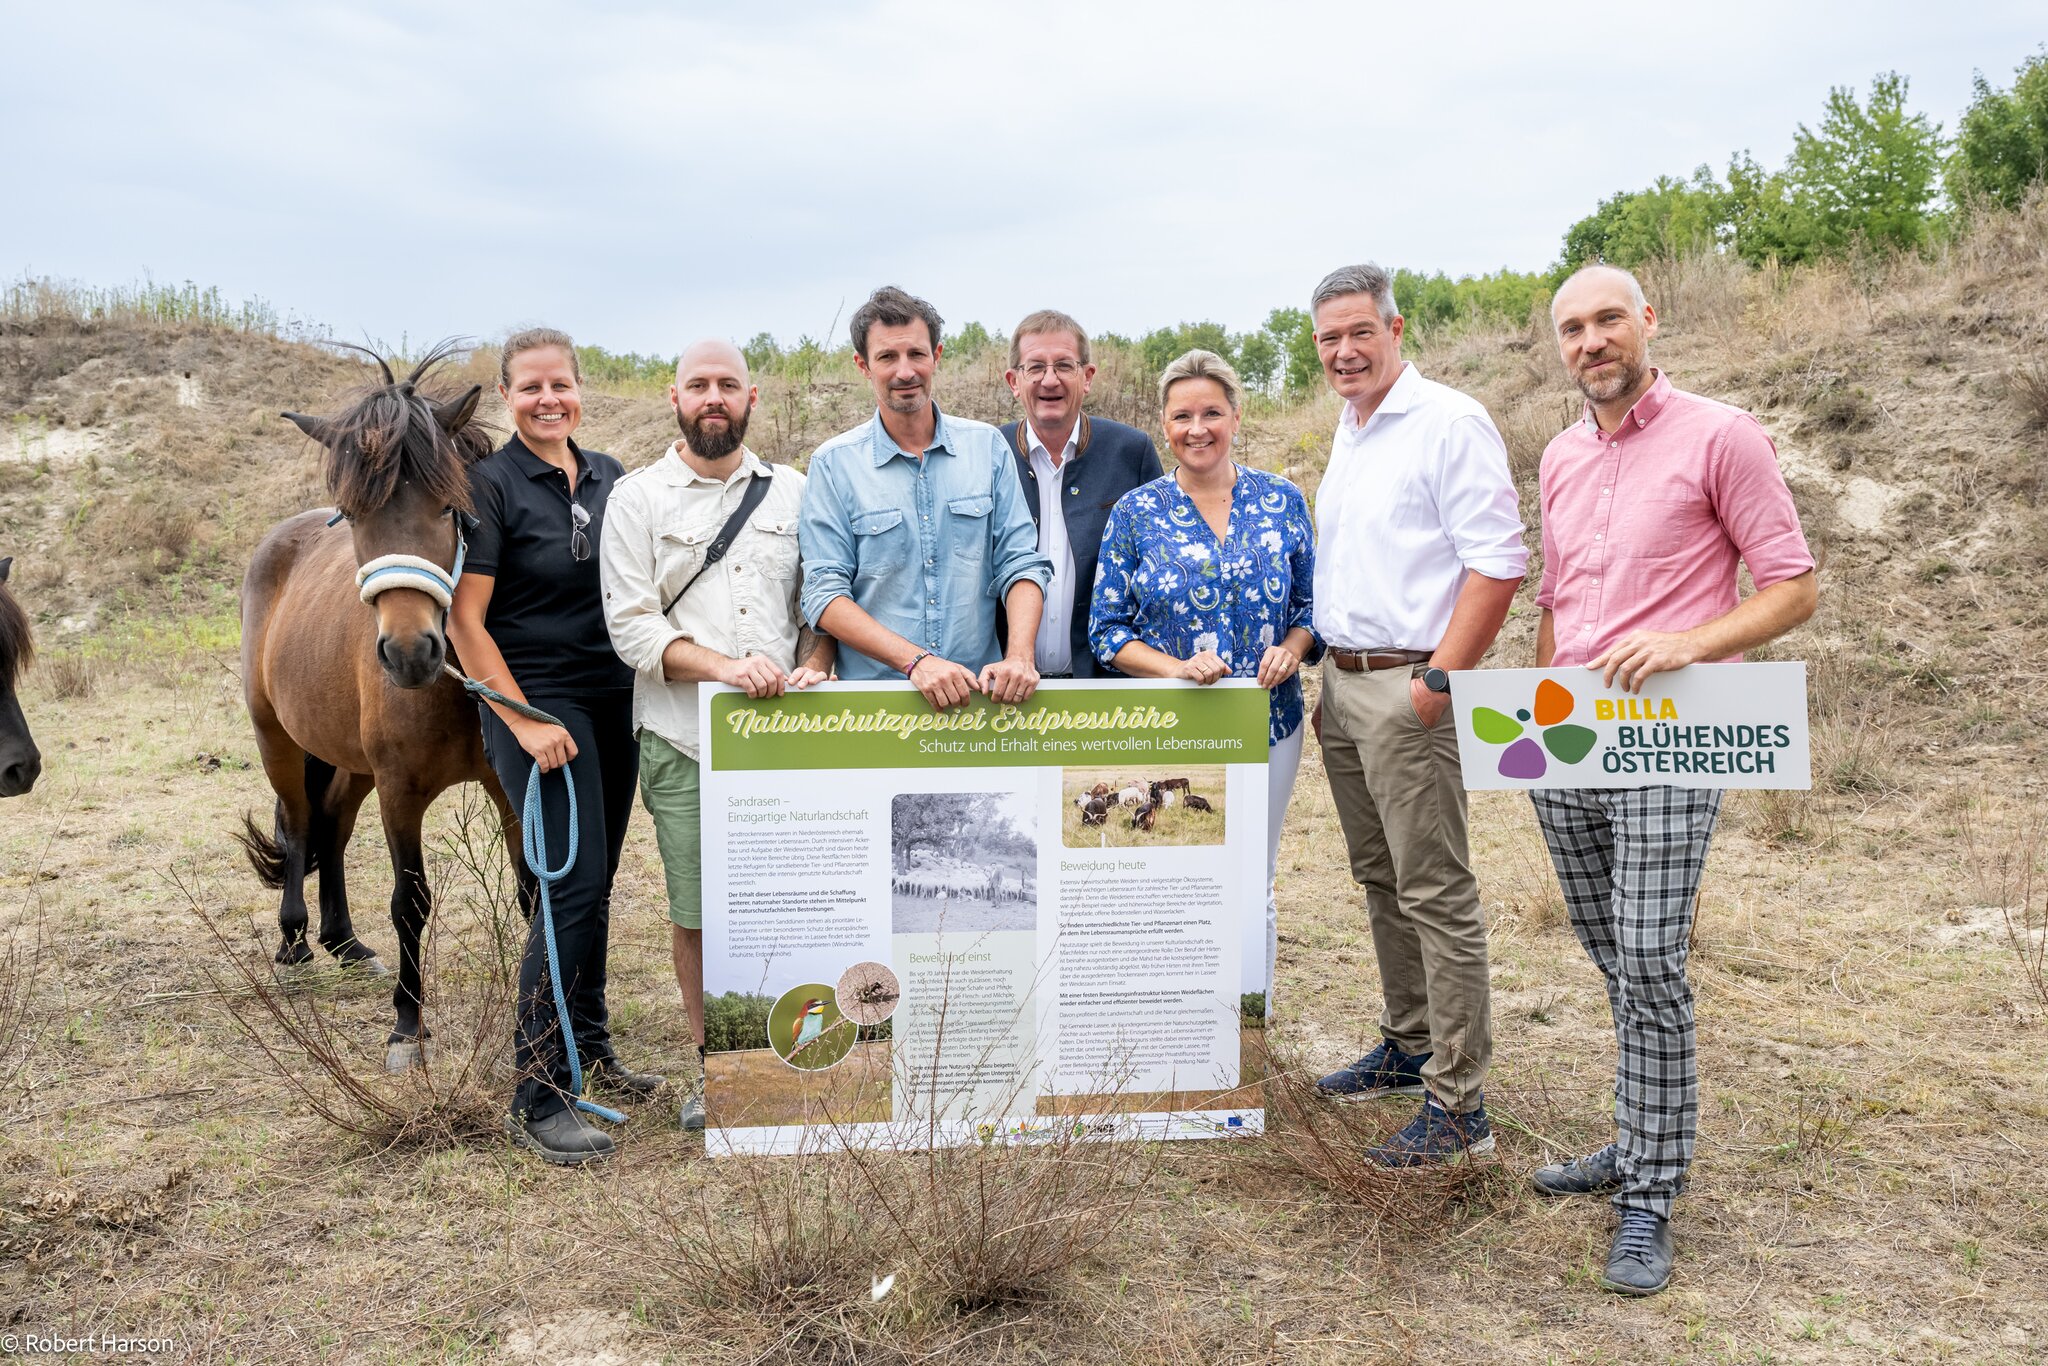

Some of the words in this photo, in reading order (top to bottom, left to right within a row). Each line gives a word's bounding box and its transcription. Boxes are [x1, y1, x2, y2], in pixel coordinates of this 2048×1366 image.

[1595, 698, 1678, 720] BILLA
[726, 708, 987, 739] Naturschutzgebiet
[991, 704, 1179, 735] Erdpresshöhe
[1618, 723, 1790, 748] BLÜHENDES
[919, 739, 965, 752] Schutz
[970, 739, 995, 752] und
[1002, 738, 1038, 751] Erhalt
[1043, 738, 1076, 751] eines
[1082, 737, 1151, 750] wertvollen
[1156, 736, 1242, 750] Lebensraums
[1602, 746, 1775, 774] ÖSTERREICH
[728, 796, 780, 807] Sandrasen
[728, 812, 786, 824] Einzigartige
[790, 810, 868, 822] Naturlandschaft
[1060, 860, 1115, 872] Beweidung
[1119, 860, 1146, 870] heute
[910, 953, 965, 964] Beweidung
[968, 952, 991, 961] einst
